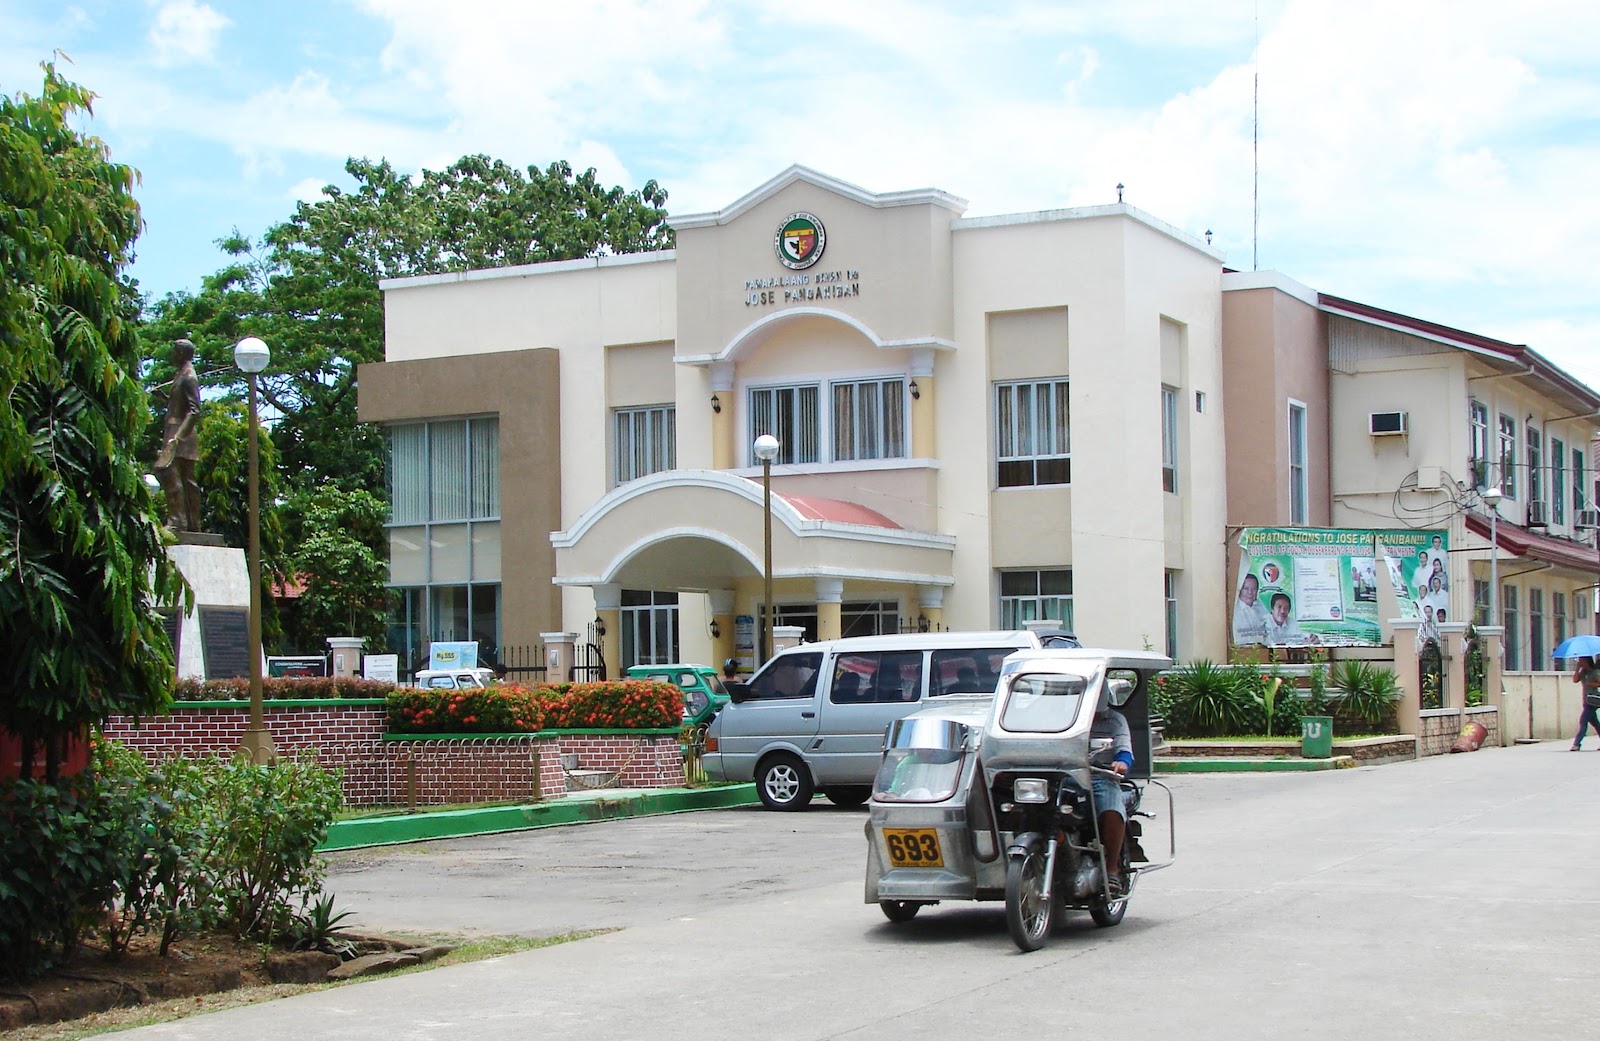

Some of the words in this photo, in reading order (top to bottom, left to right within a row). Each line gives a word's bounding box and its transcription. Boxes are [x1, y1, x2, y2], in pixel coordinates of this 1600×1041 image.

[745, 291, 775, 307] JOSE
[784, 283, 859, 303] PANGANIBAN
[1246, 532, 1320, 543] NGRATULATIONS
[1322, 533, 1334, 543] TO
[1336, 533, 1358, 544] JOSE
[888, 834, 939, 861] 693
